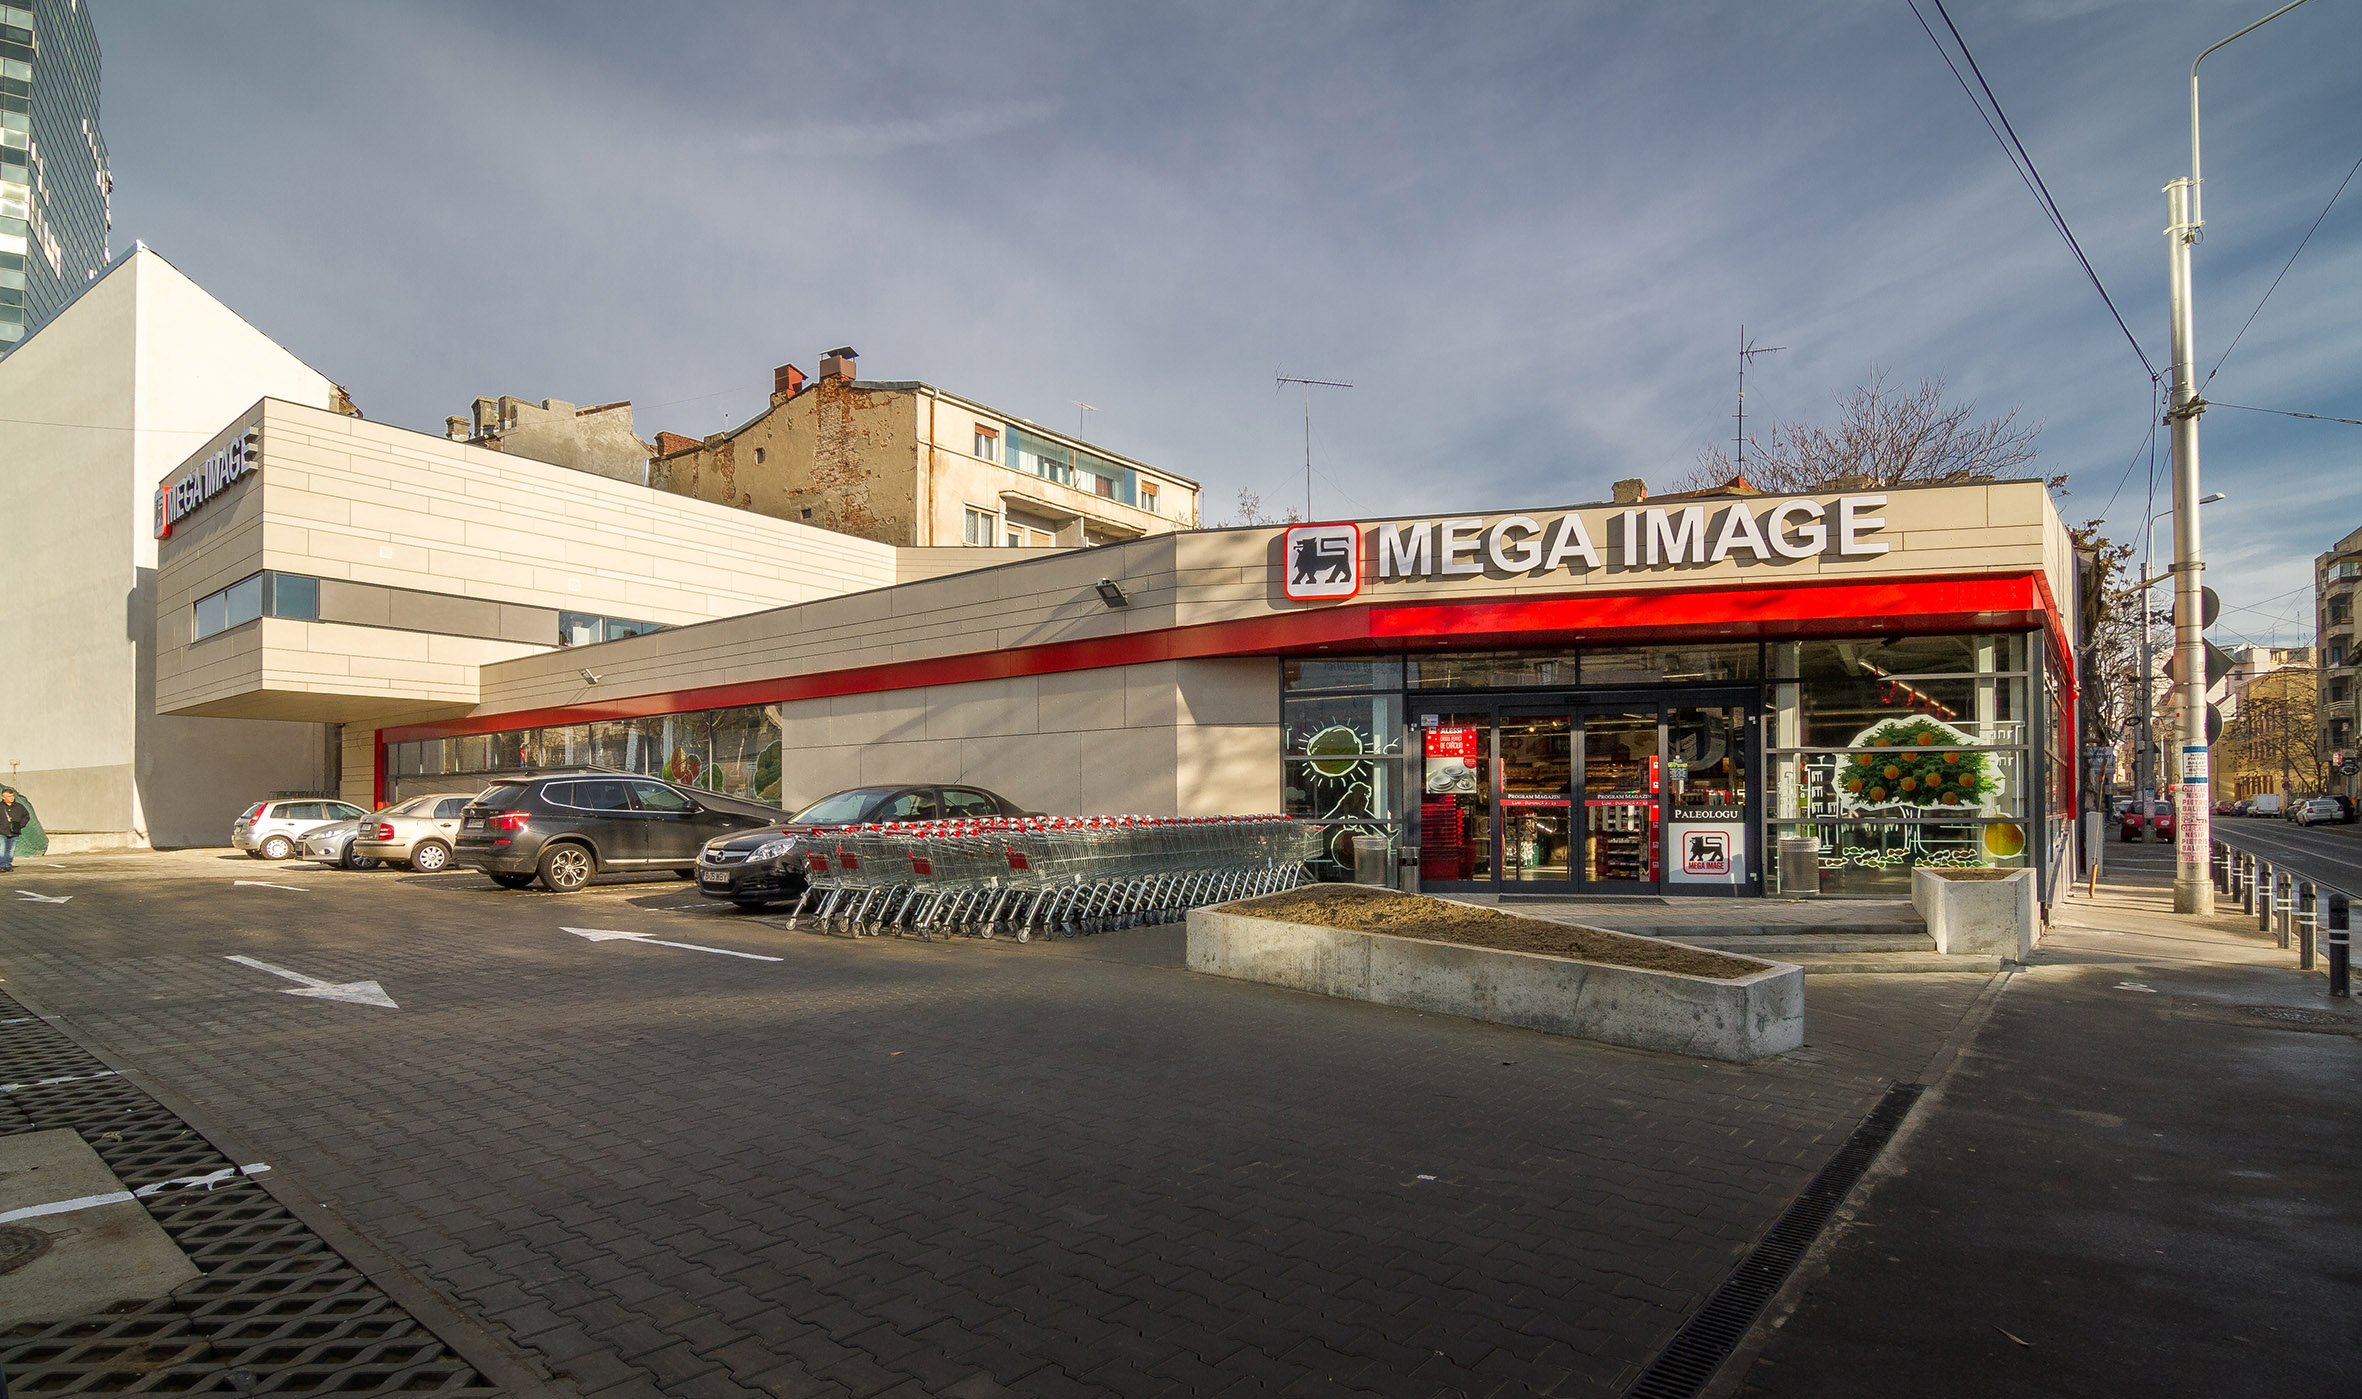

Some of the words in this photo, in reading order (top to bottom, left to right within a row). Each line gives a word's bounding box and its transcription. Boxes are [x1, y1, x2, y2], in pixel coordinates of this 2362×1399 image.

[167, 467, 203, 525] MEGA
[204, 427, 258, 499] IMAGE
[1379, 512, 1601, 577] MEGA
[1624, 494, 1890, 566] IMAGE
[1674, 809, 1738, 819] PALEOLOGU
[1688, 861, 1705, 869] MEGA
[1706, 861, 1724, 869] IMAGE
